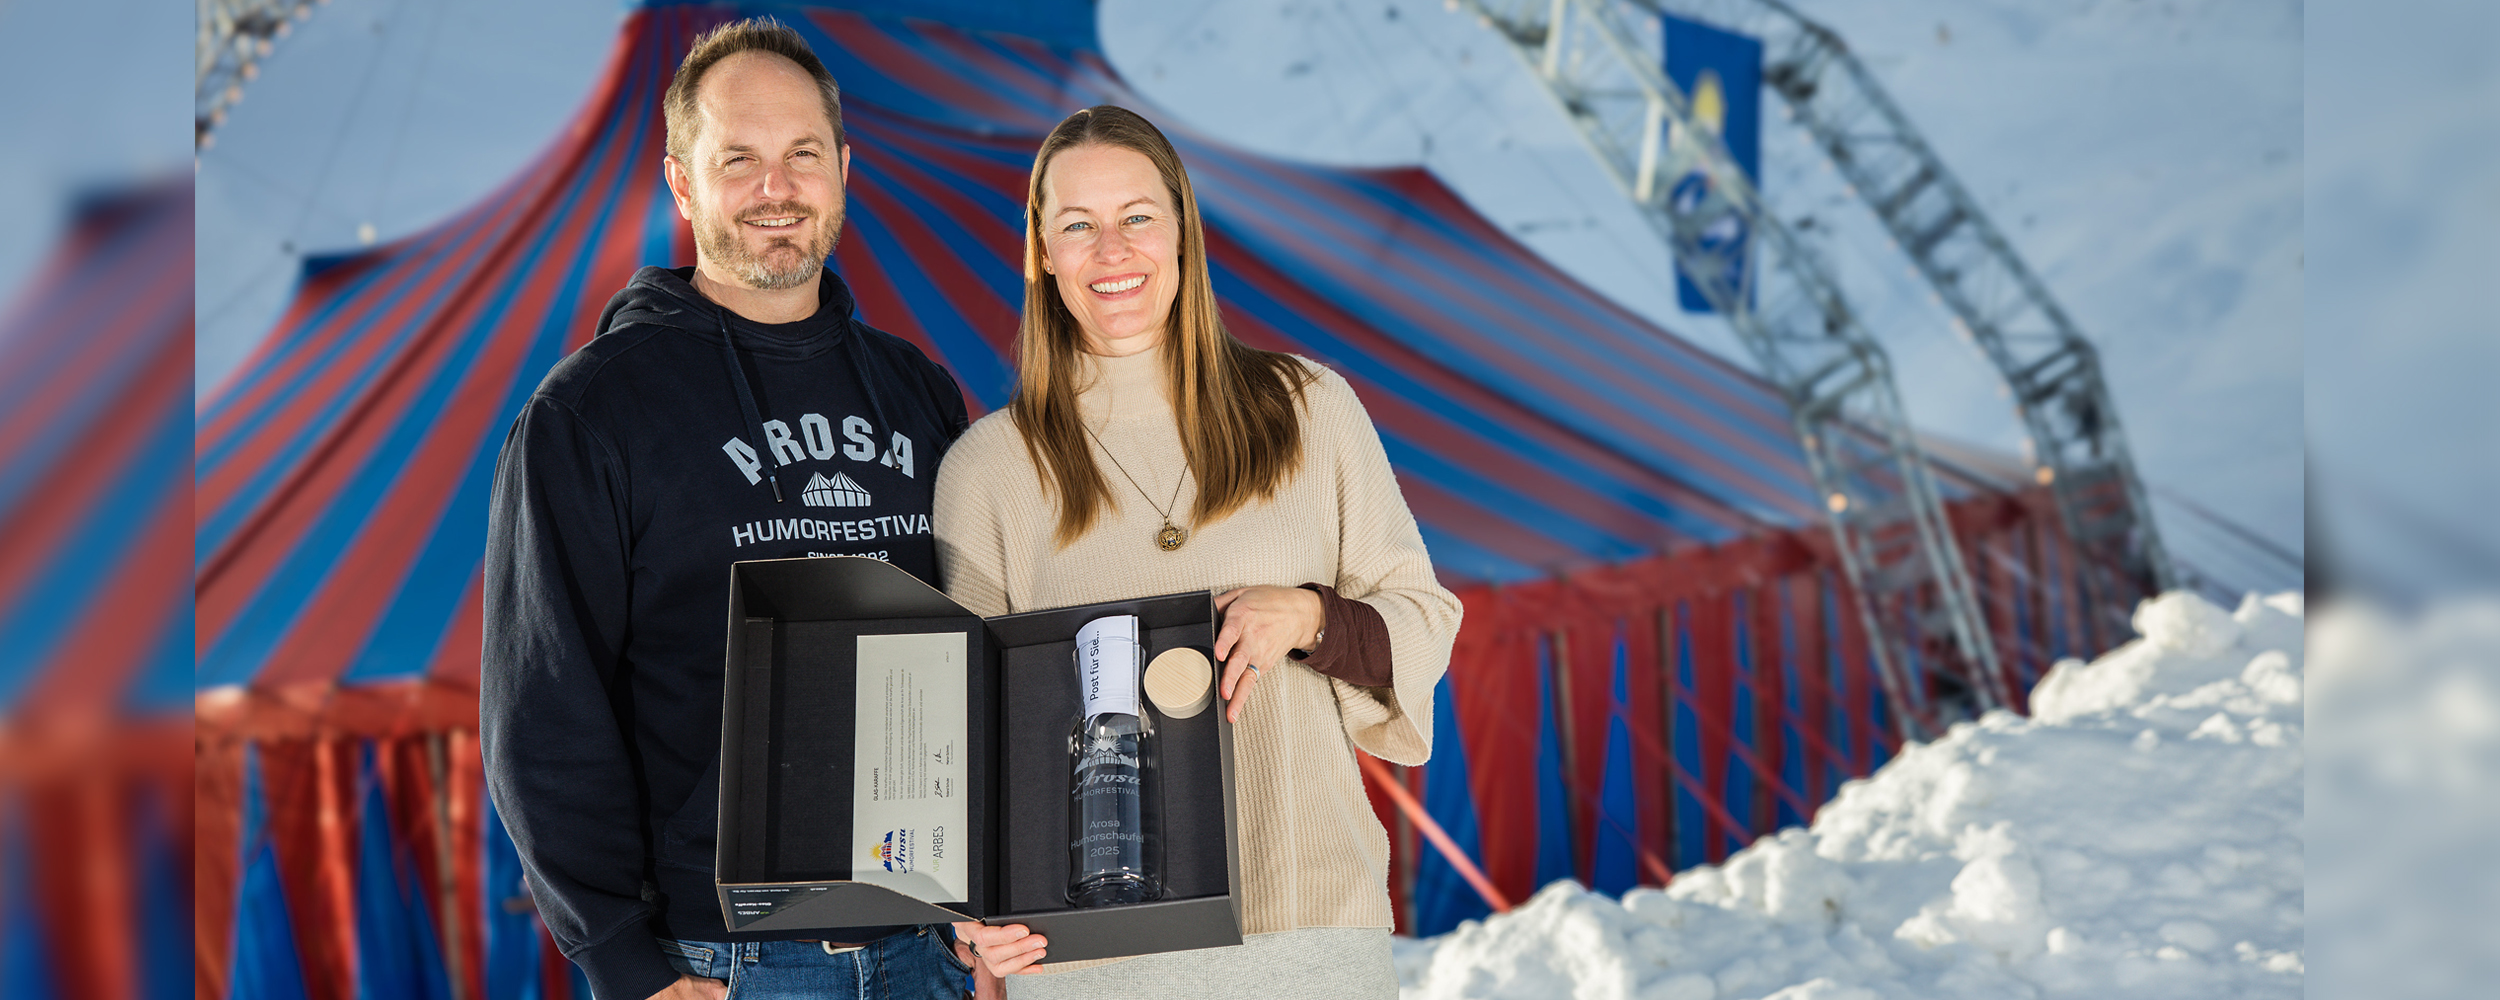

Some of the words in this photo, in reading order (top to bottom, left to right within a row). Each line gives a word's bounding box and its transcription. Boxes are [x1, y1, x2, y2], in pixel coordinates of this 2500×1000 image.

[722, 413, 915, 486] AROSA
[732, 514, 934, 547] HUMORFESTIVA
[1089, 658, 1099, 675] für
[1089, 676, 1099, 701] Post
[1072, 769, 1141, 794] Arosa
[1073, 787, 1140, 802] HUMORFESTIVAL
[1089, 820, 1120, 830] Arosa
[894, 828, 907, 874] Arosa
[1070, 831, 1145, 851] Humorschaufel
[1090, 846, 1120, 858] 2025
